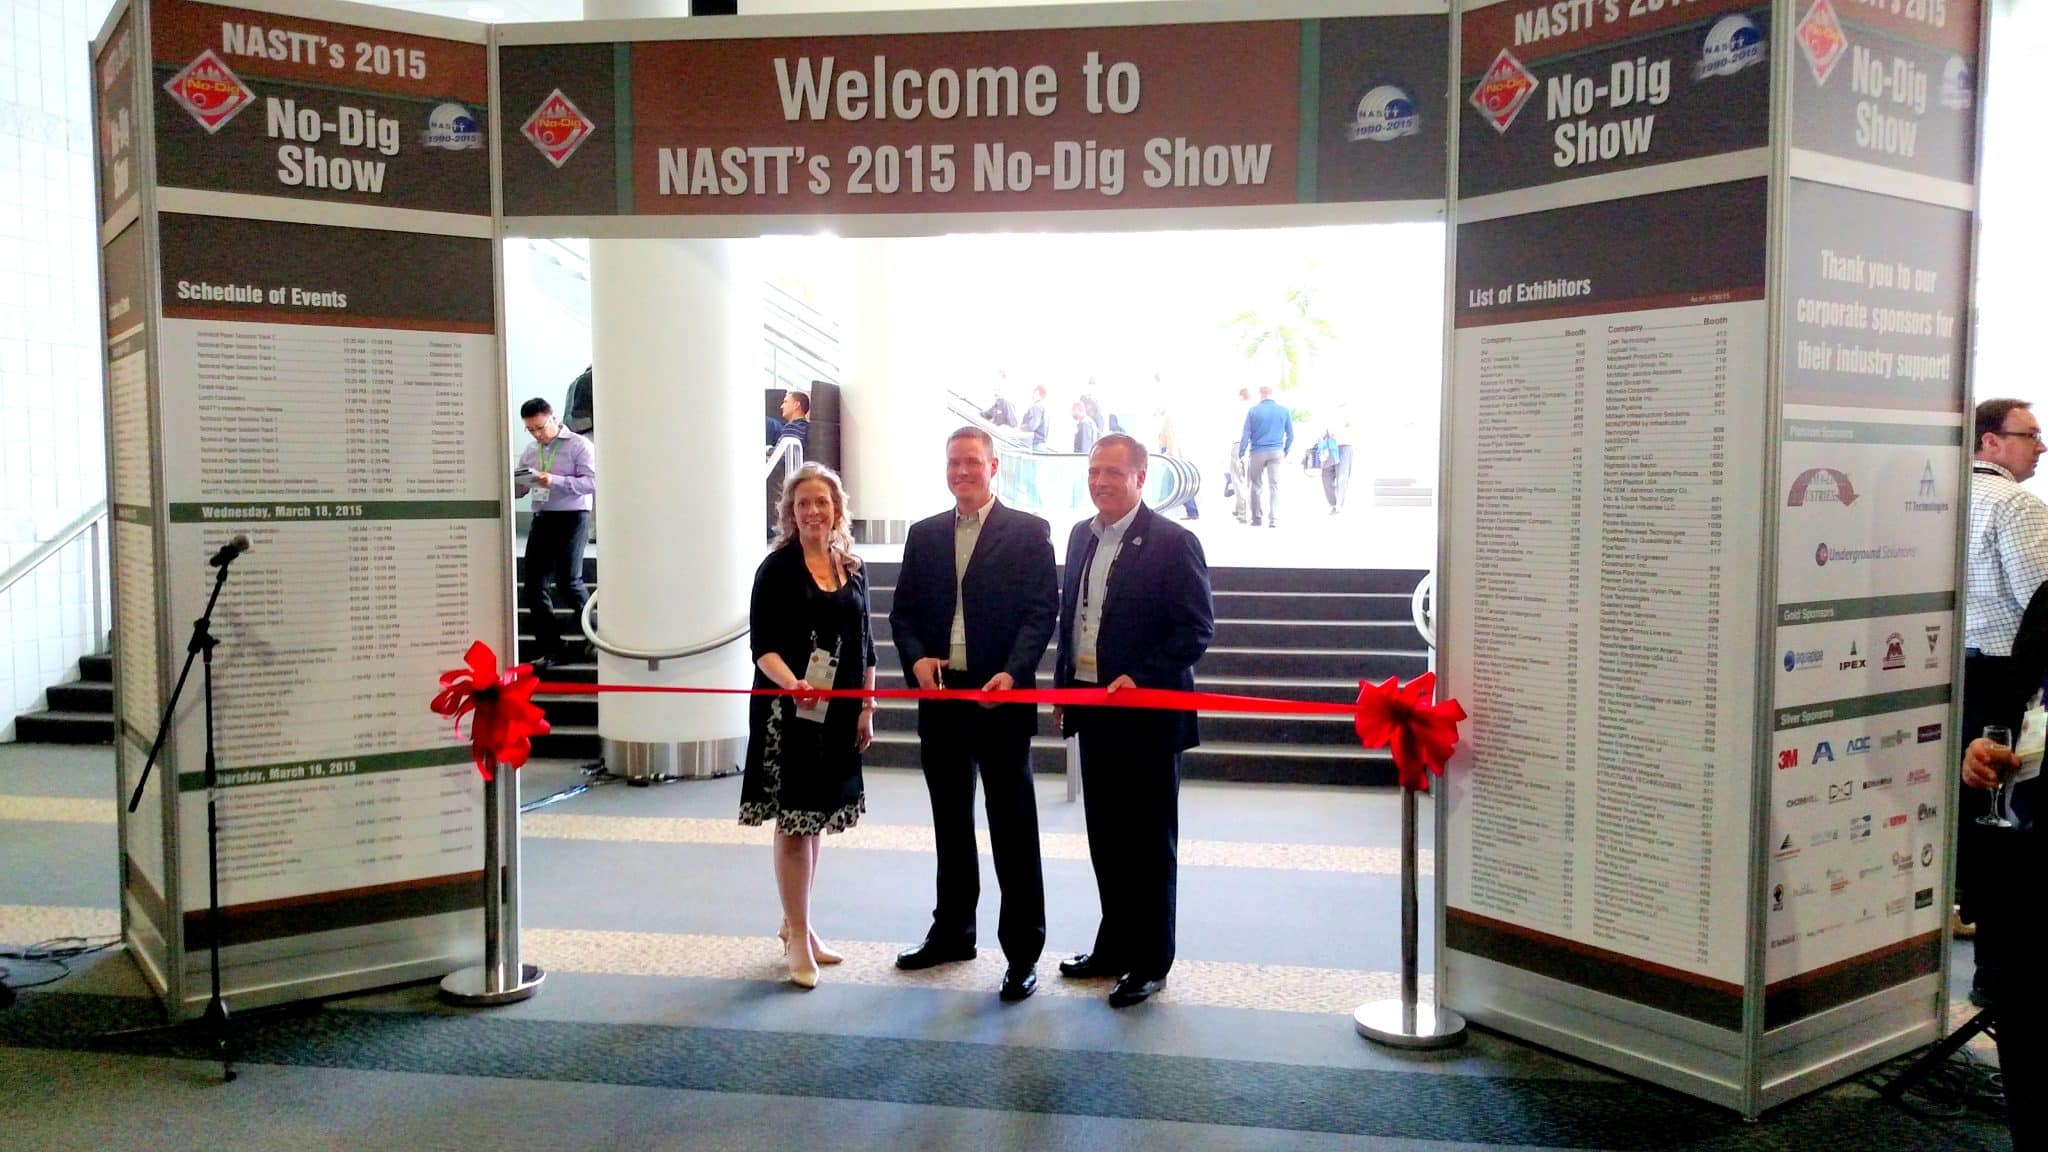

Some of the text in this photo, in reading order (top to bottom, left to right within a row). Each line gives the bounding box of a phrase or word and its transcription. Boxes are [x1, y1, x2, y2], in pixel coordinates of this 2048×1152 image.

[222, 22, 426, 80] NASTT's 2015
[773, 51, 1141, 121] Welcome to
[1547, 56, 1671, 120] No-Dig
[1852, 45, 1927, 114] No-Dig
[267, 97, 400, 156] No-Dig
[1553, 115, 1655, 167] Show
[1855, 101, 1917, 158] Show
[278, 144, 387, 193] Show
[658, 136, 1273, 196] NASTT's 2015 No-Dig Show
[1469, 278, 1592, 308] List of Exhibitors
[1821, 249, 1937, 293] Thank you to our
[177, 281, 348, 308] Schedule of Events
[1797, 298, 1955, 338] corporate sponsors for
[1798, 340, 1951, 382] their industry support!
[201, 505, 363, 519] Wednesday, March 18, 2015
[1839, 659, 1866, 671] IPEX
[216, 771, 266, 785] hursday,
[269, 766, 305, 780] March
[329, 760, 357, 775] 2015
[1778, 748, 1799, 770] 3M
